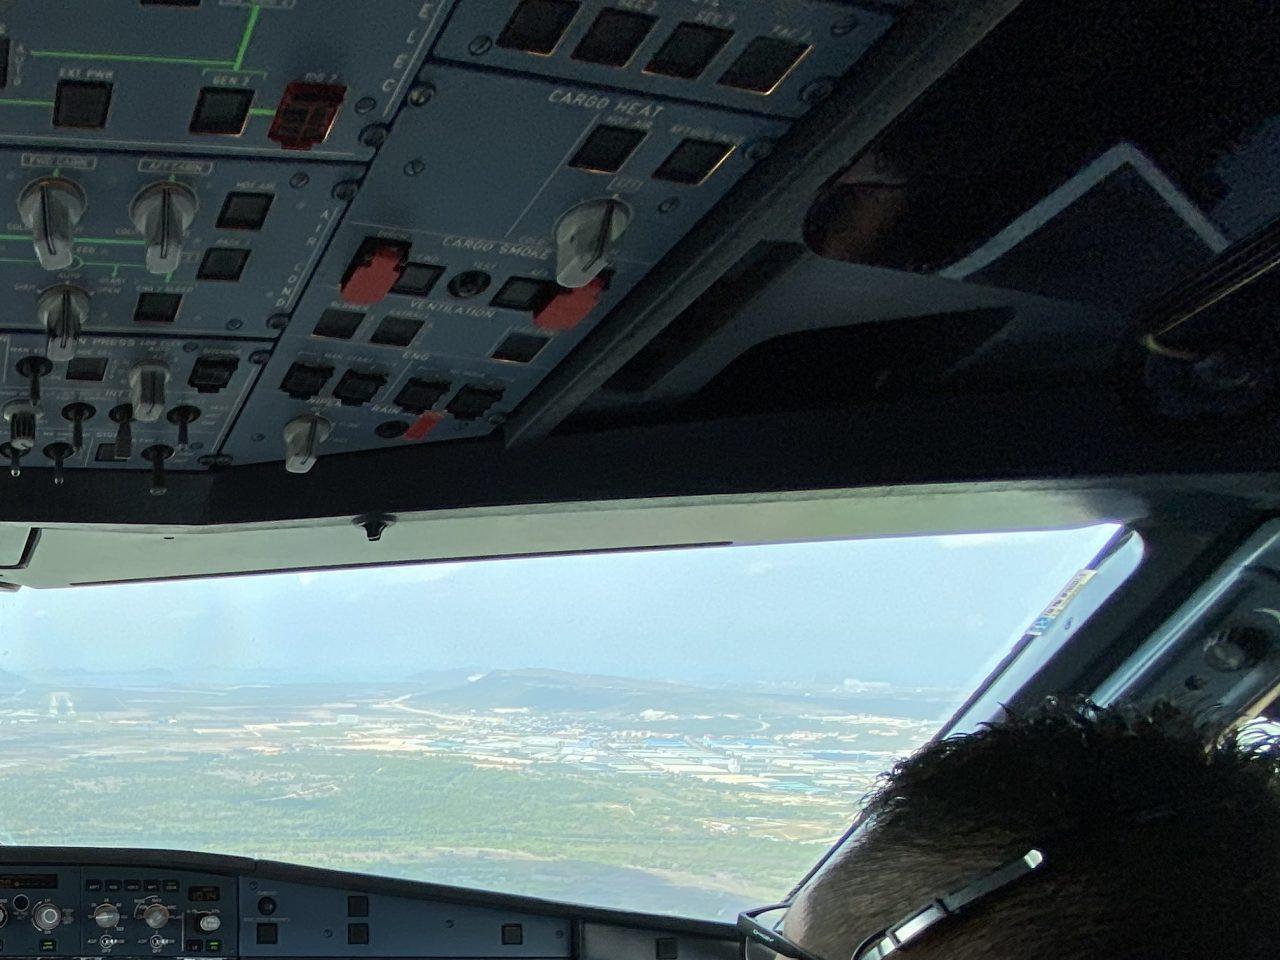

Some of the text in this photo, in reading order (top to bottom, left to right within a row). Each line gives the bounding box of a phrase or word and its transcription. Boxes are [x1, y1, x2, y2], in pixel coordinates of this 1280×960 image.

[548, 88, 664, 118] CARGO HEAT
[442, 235, 552, 261] CARGO SMOKE
[409, 299, 497, 320] VENTILATION
